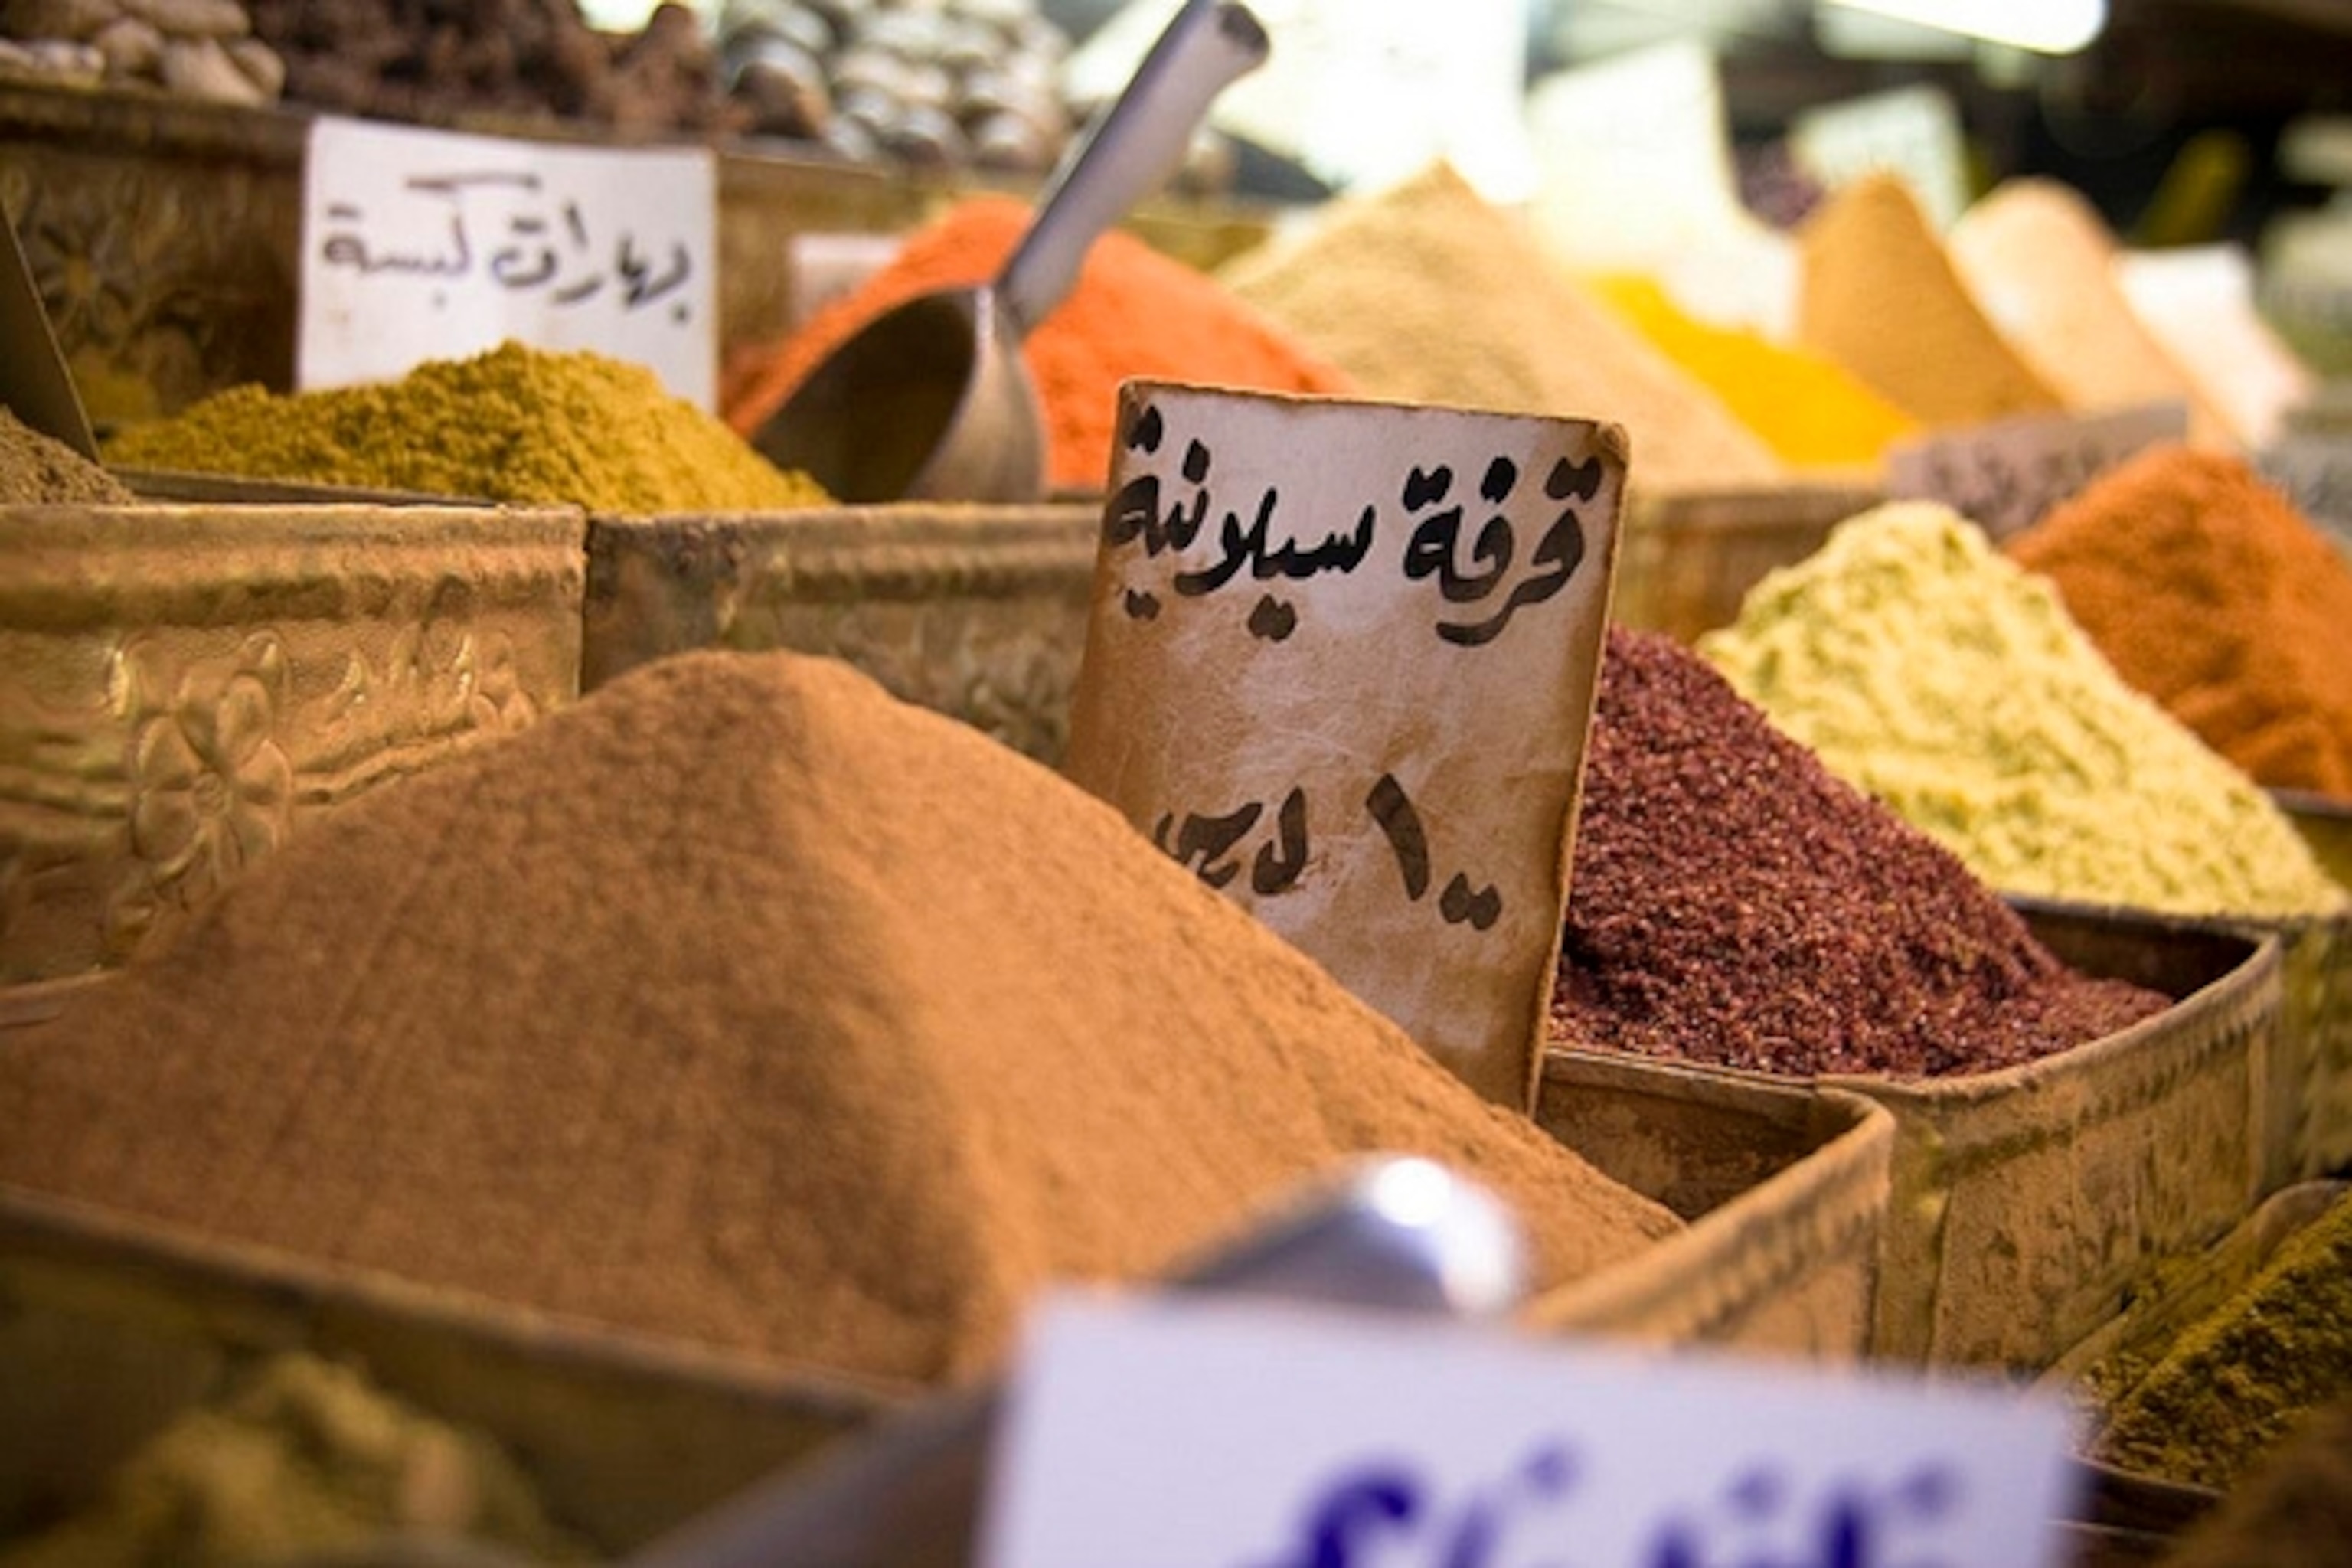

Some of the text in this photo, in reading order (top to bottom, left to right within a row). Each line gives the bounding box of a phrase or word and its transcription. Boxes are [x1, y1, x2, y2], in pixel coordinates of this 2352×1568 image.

[322, 172, 693, 325] بهارات كبسة
[1105, 401, 1602, 648] قرفة سيلانية
